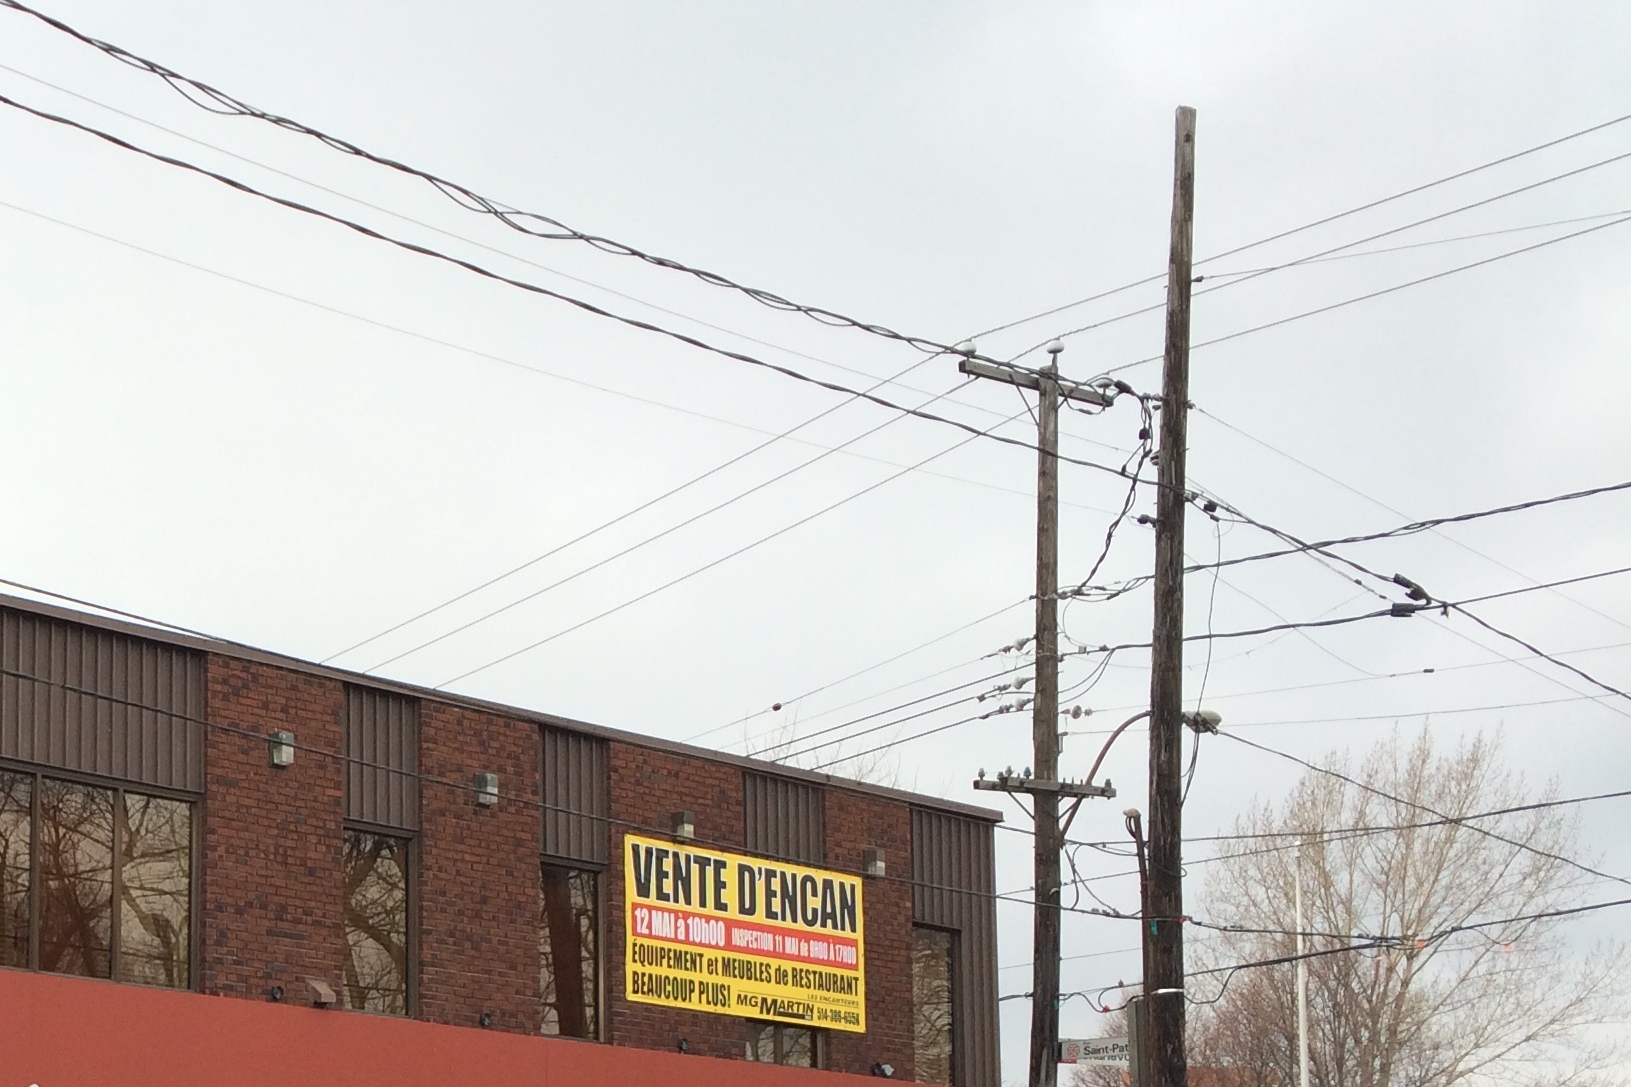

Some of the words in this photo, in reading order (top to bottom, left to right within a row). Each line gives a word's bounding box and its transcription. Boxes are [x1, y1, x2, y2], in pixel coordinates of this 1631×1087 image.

[631, 843, 728, 912] VENTE
[737, 862, 857, 933] D'ENCAN
[635, 908, 649, 934] 12
[652, 910, 675, 938] MAI
[677, 913, 685, 940] à
[687, 916, 725, 946] 10h00
[732, 927, 774, 952] INSPECTION
[775, 935, 783, 953] 11
[785, 936, 799, 955] MAI
[800, 938, 809, 957] de
[632, 939, 704, 973] ÉQUIPEMENT
[707, 957, 719, 976] et
[722, 957, 771, 983] MEUBLES
[775, 965, 788, 986] de
[792, 967, 859, 996] RESTAURANT
[632, 971, 695, 1003] BEAUCOUP
[698, 981, 731, 1008] PLUS!
[759, 997, 814, 1016] MARTIN
